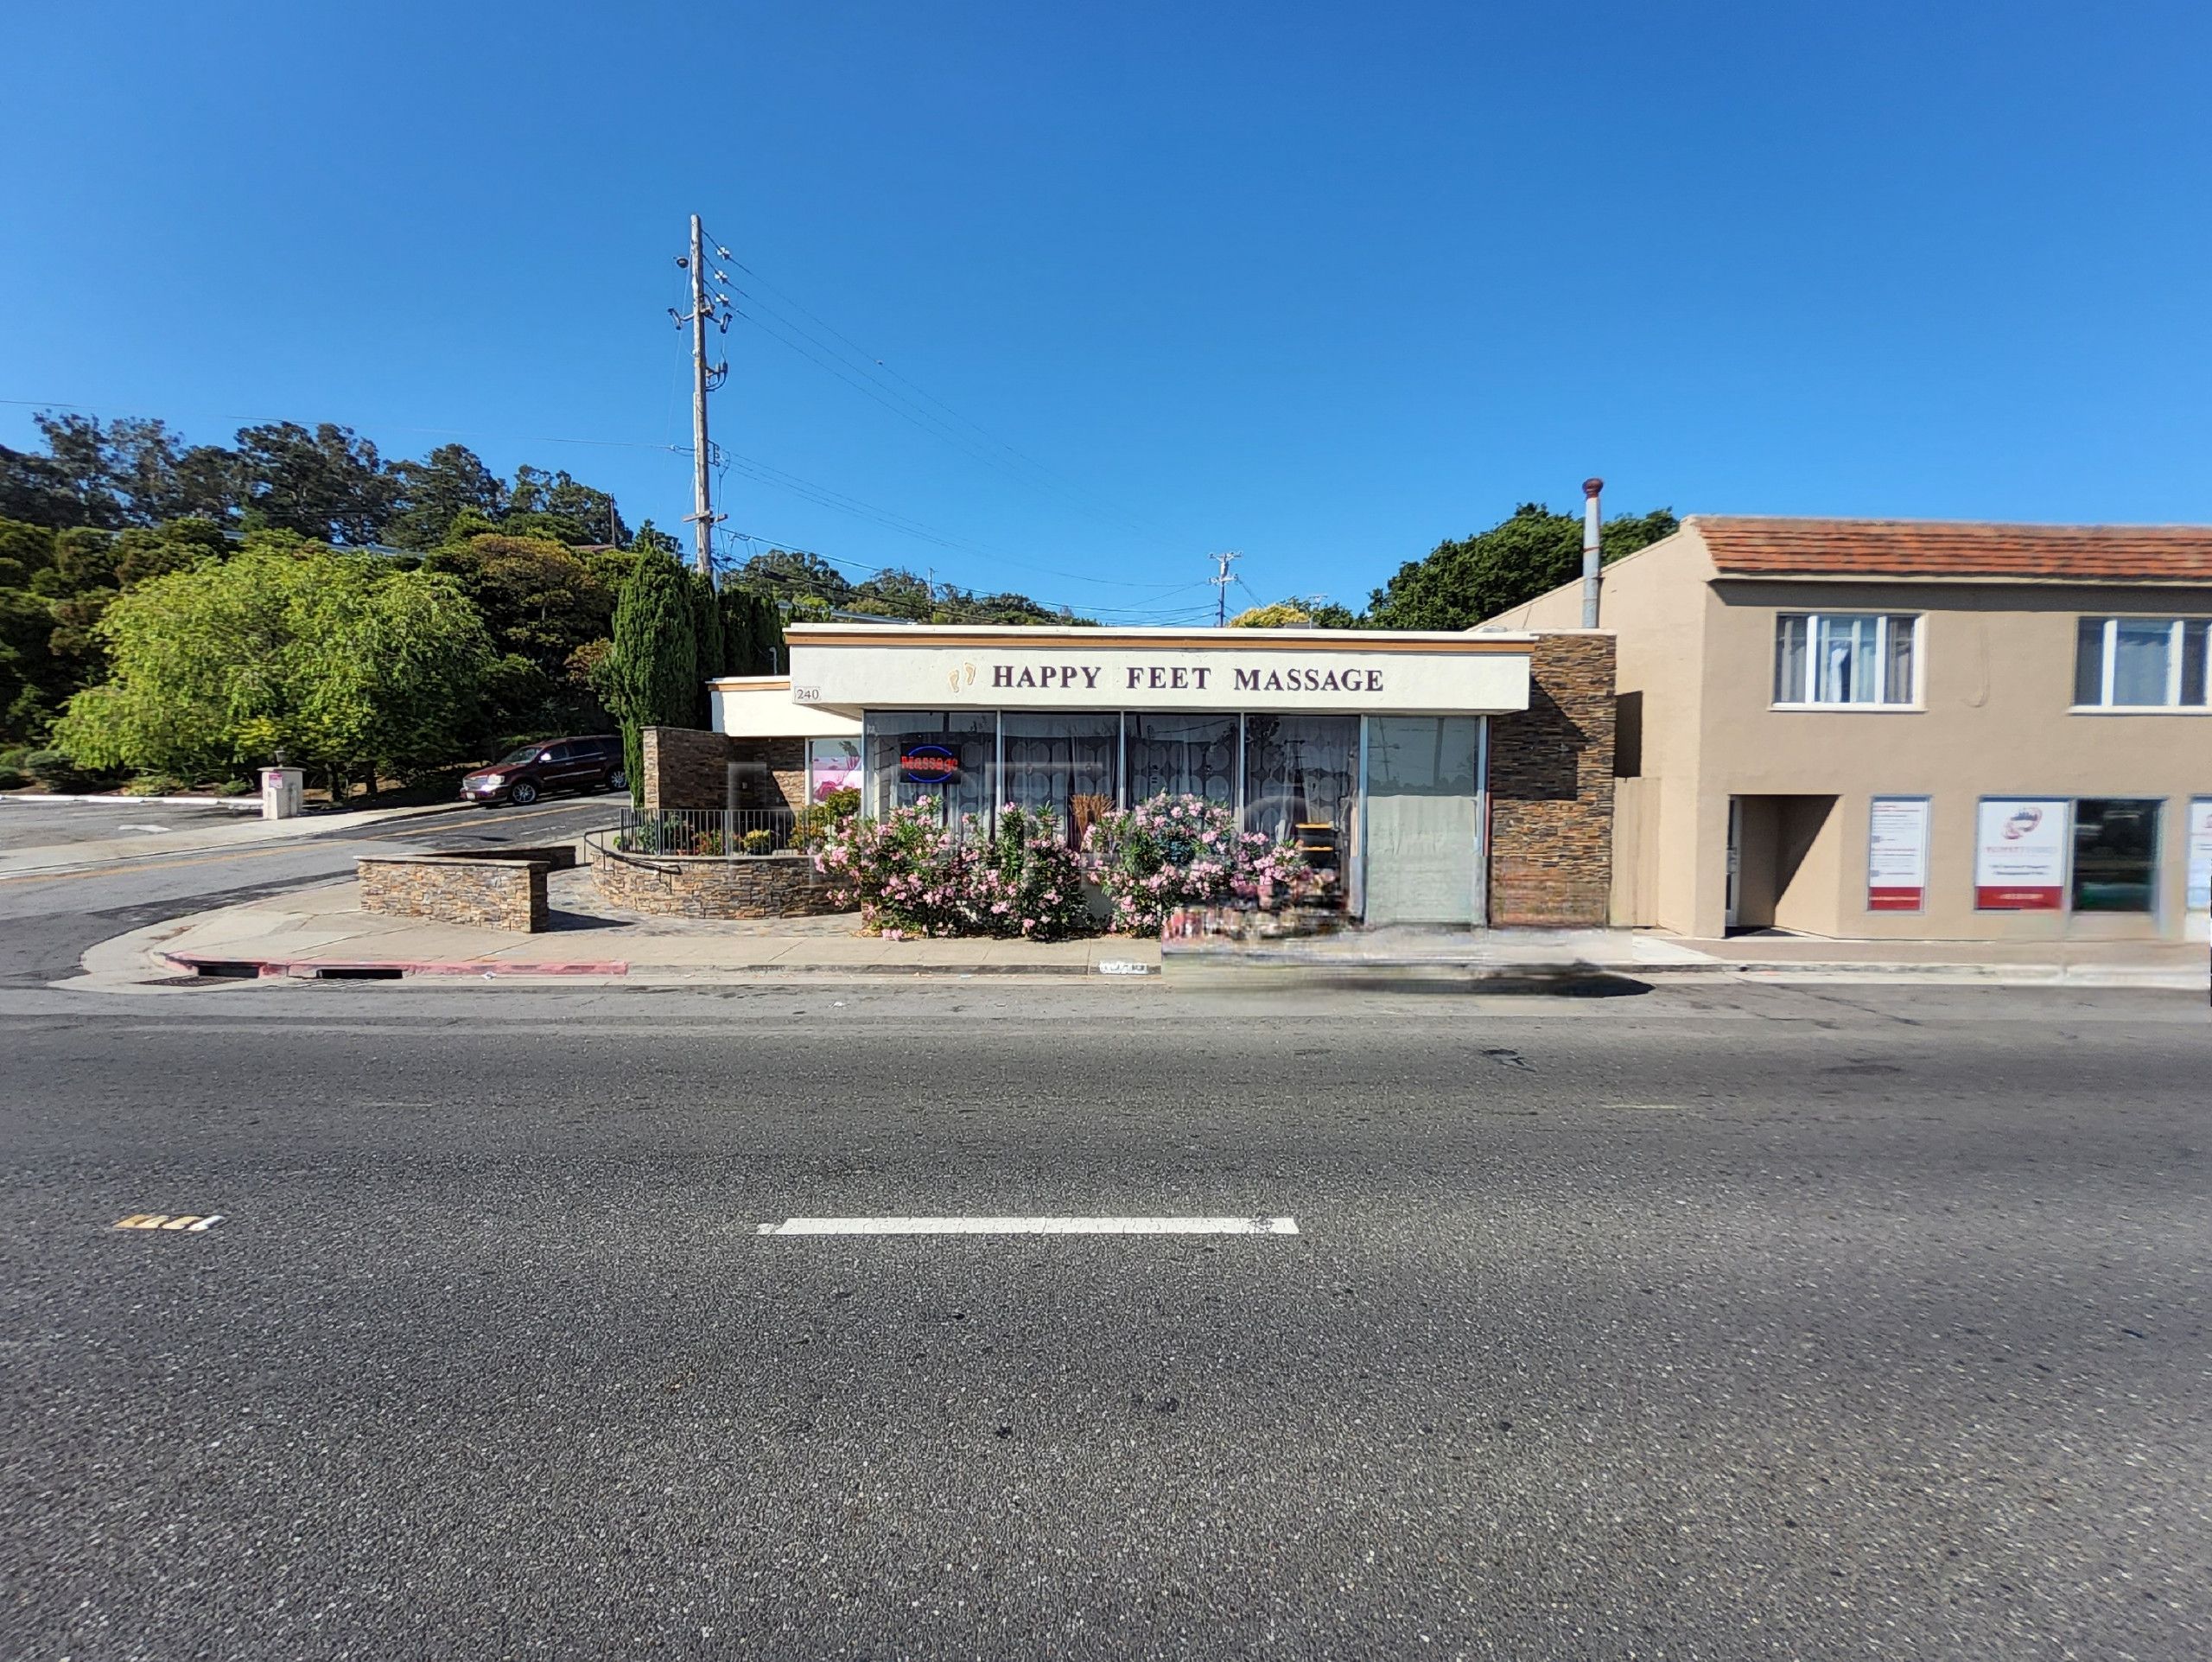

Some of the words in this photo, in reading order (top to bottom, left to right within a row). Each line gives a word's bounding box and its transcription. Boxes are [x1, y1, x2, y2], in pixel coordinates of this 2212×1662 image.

[992, 665, 1102, 689] HAPPY
[1126, 666, 1211, 690] FEET
[1234, 668, 1383, 691] MASSAGE
[797, 689, 819, 700] 240
[901, 755, 958, 773] Massage
